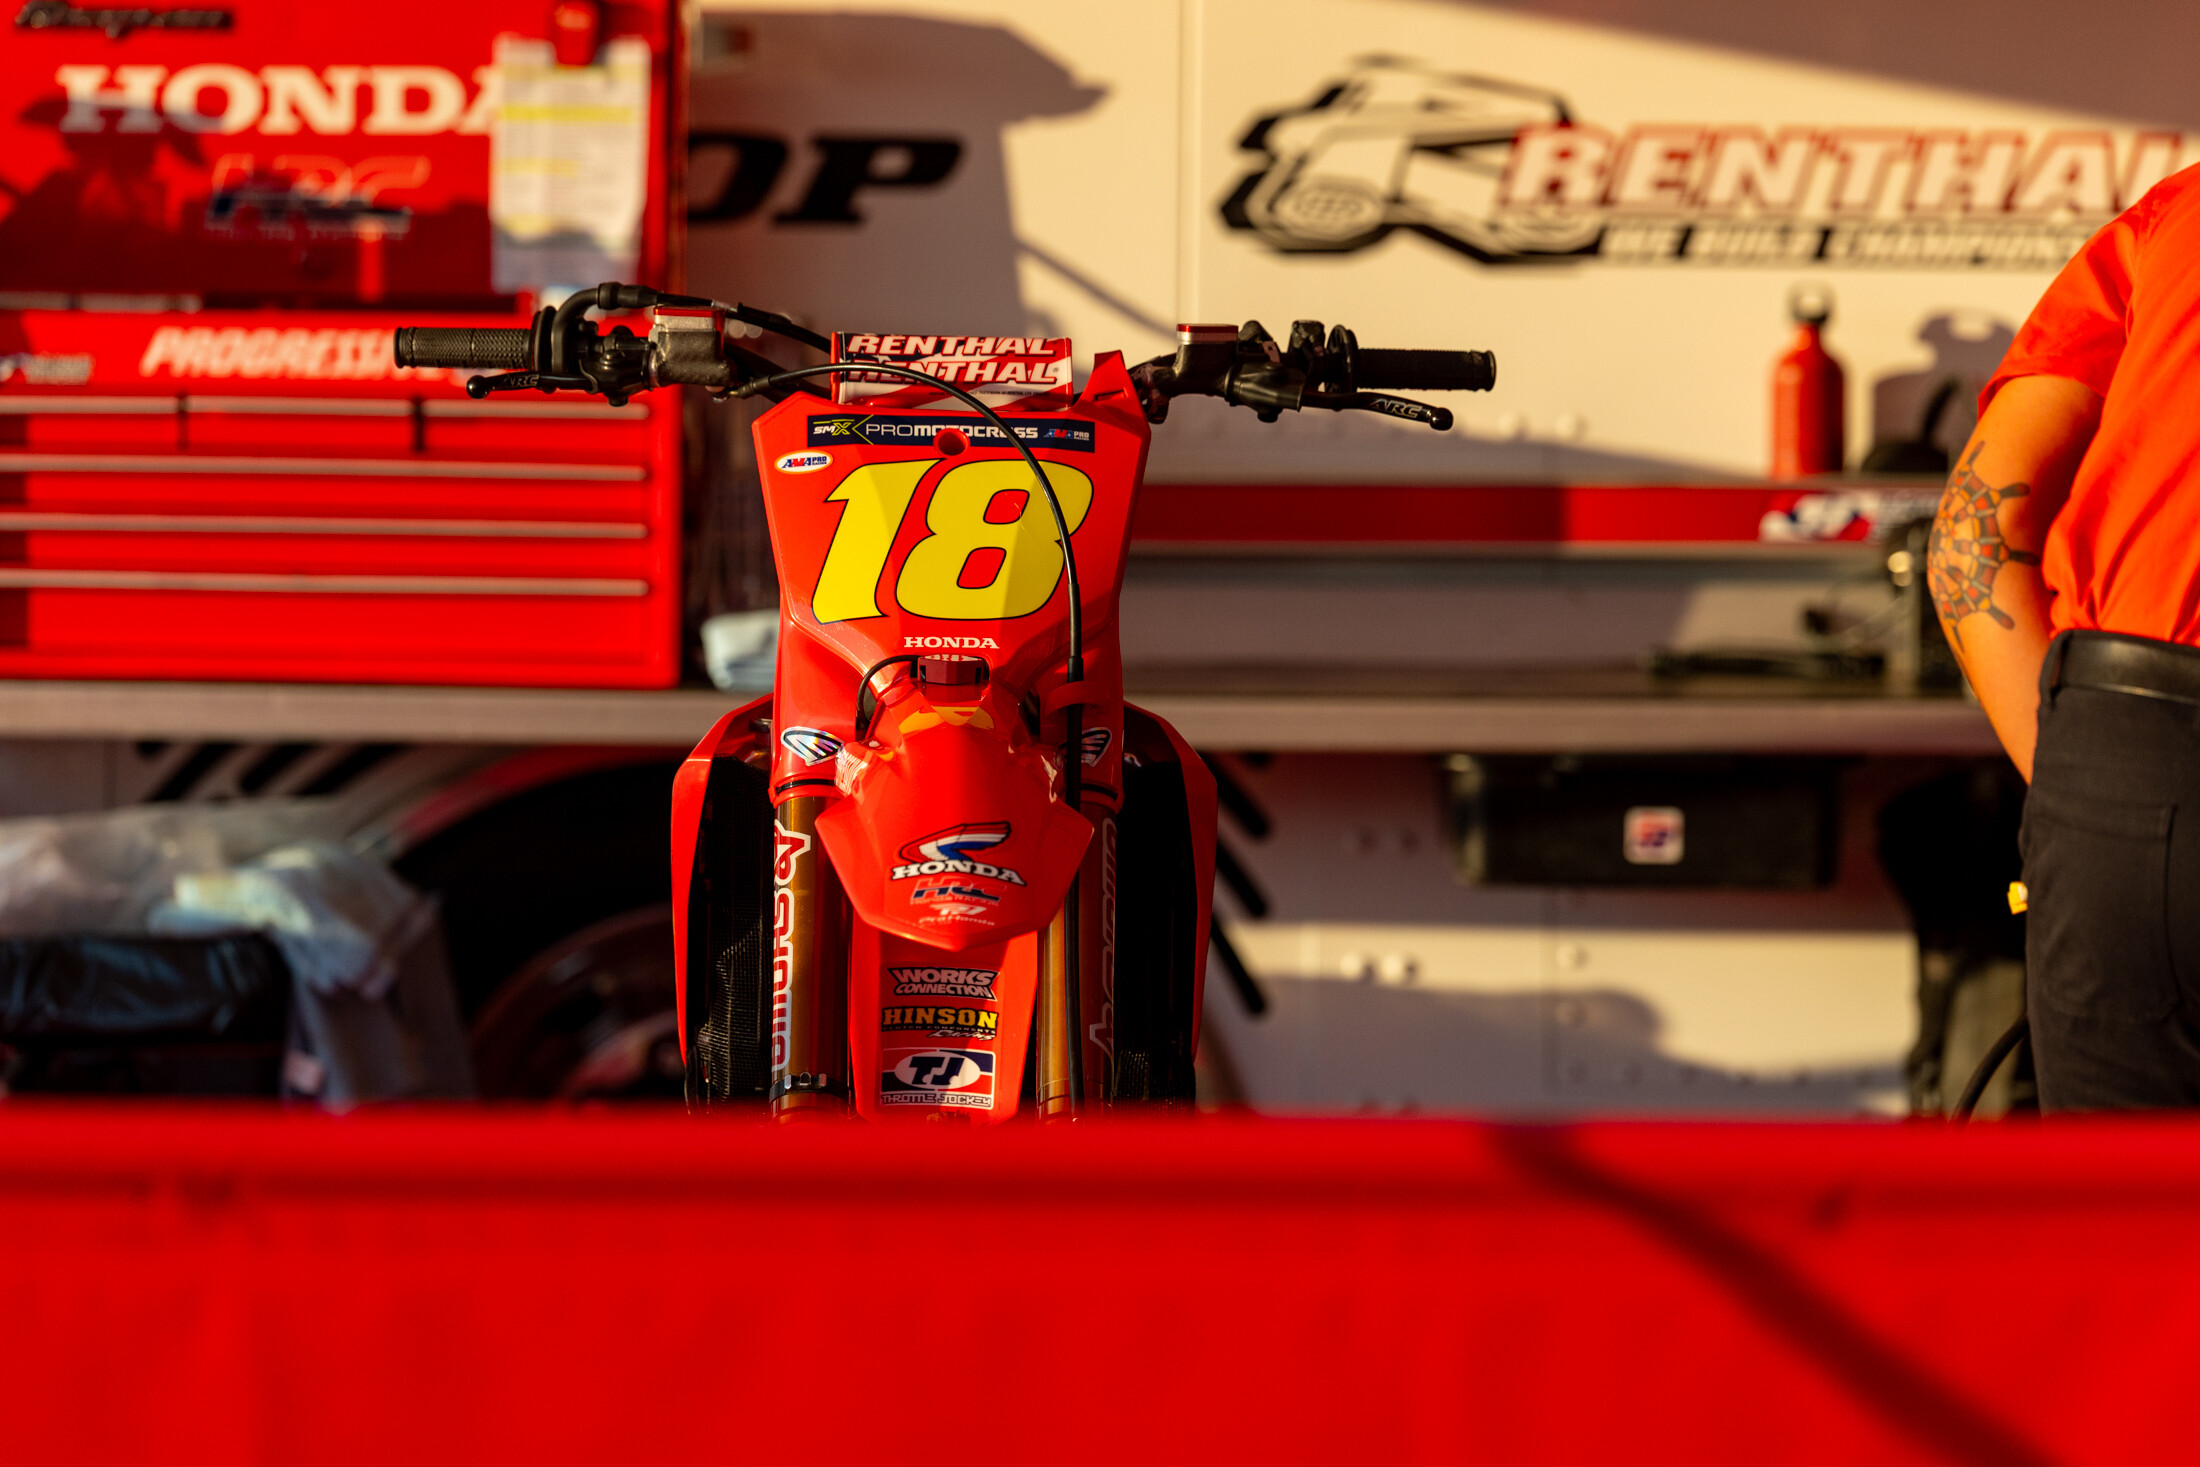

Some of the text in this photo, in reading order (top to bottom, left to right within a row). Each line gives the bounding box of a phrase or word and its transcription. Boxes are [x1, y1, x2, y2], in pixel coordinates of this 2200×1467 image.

[847, 335, 1057, 356] RENTHAL
[847, 359, 1058, 384] RENTHAL
[1368, 398, 1422, 419] ARC
[813, 421, 852, 436] SMX
[1073, 430, 1089, 438] PRO
[781, 457, 811, 468] AMA
[811, 458, 1094, 625] 18
[904, 636, 1000, 649] HONDA
[892, 860, 1027, 887] HONDA
[891, 968, 996, 986] WORKS
[895, 983, 994, 999] CONNECTION
[883, 1007, 998, 1029] HINSON
[909, 1056, 965, 1085] TJ
[881, 1093, 992, 1108] THROTTLE JOCKEY
